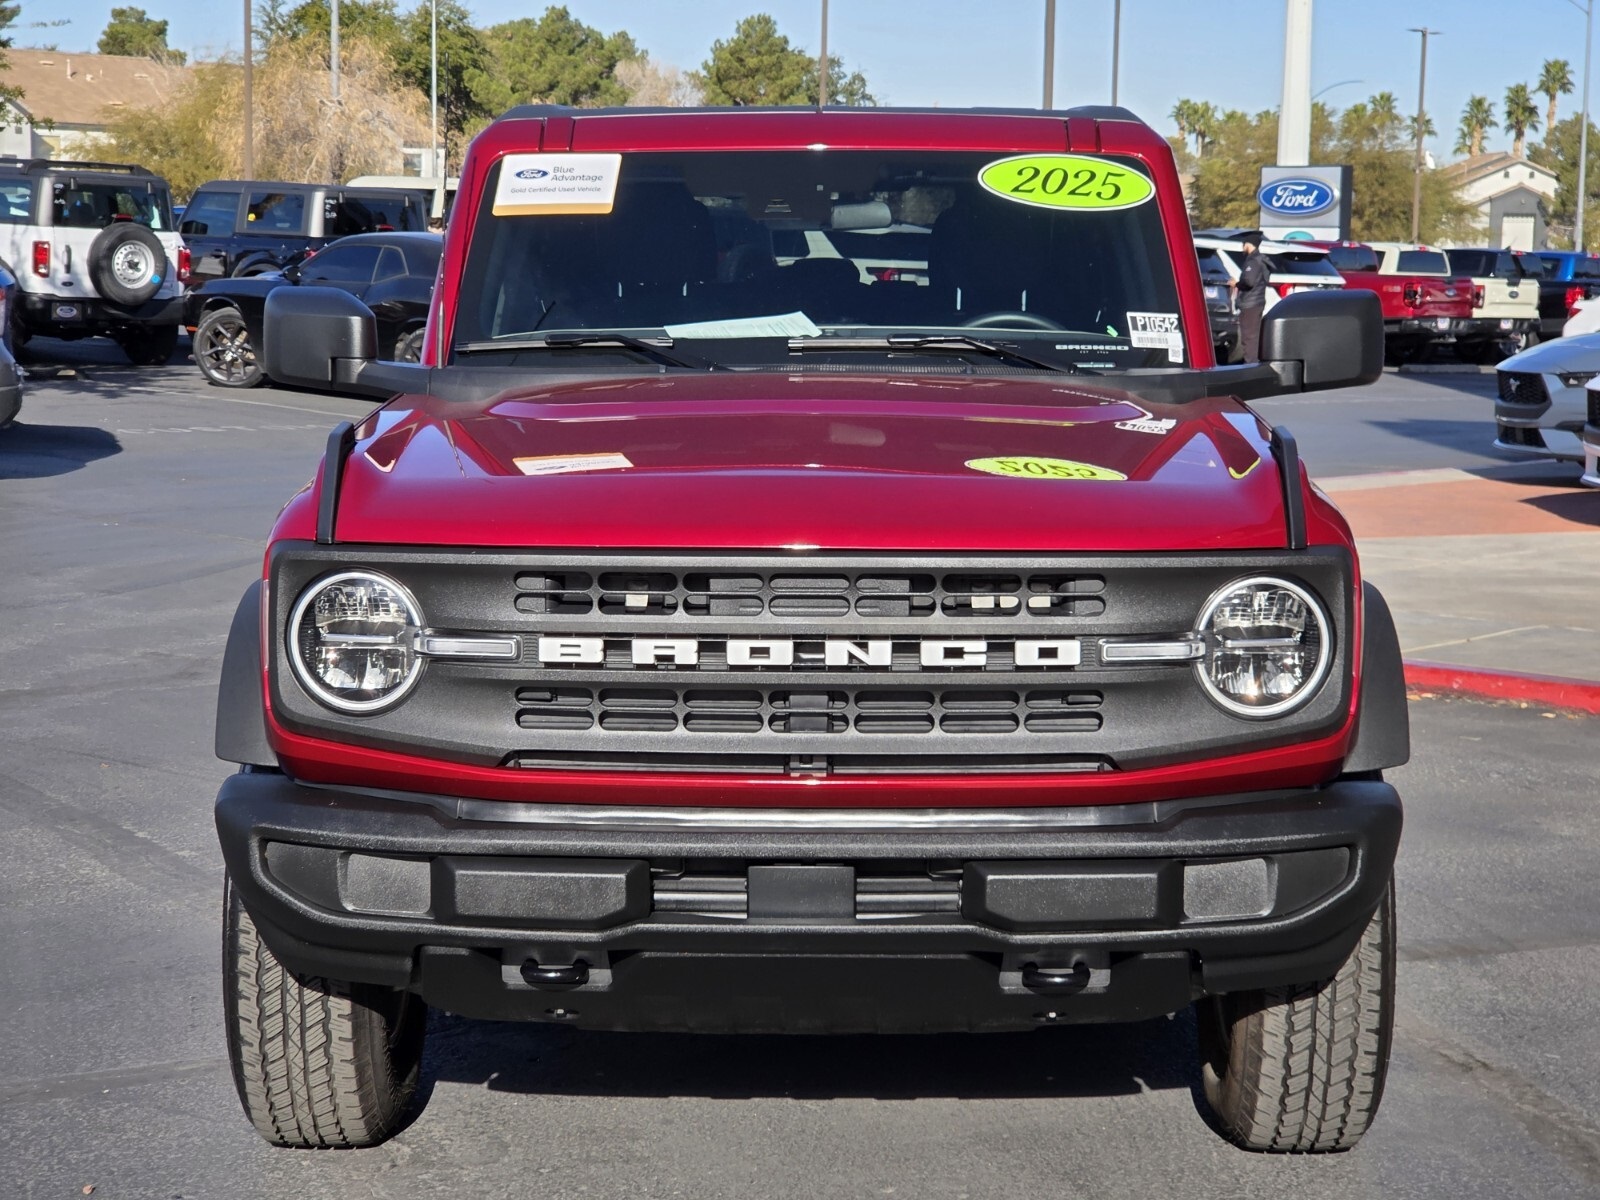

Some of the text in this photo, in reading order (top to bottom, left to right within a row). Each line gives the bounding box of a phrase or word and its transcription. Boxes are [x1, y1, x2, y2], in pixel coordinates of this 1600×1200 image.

[520, 169, 543, 179] Ford
[551, 174, 603, 182] Advantage
[1010, 166, 1126, 200] 2025
[1272, 184, 1319, 207] Ford
[1136, 316, 1179, 332] P10542
[538, 637, 1081, 666] BRONCO
